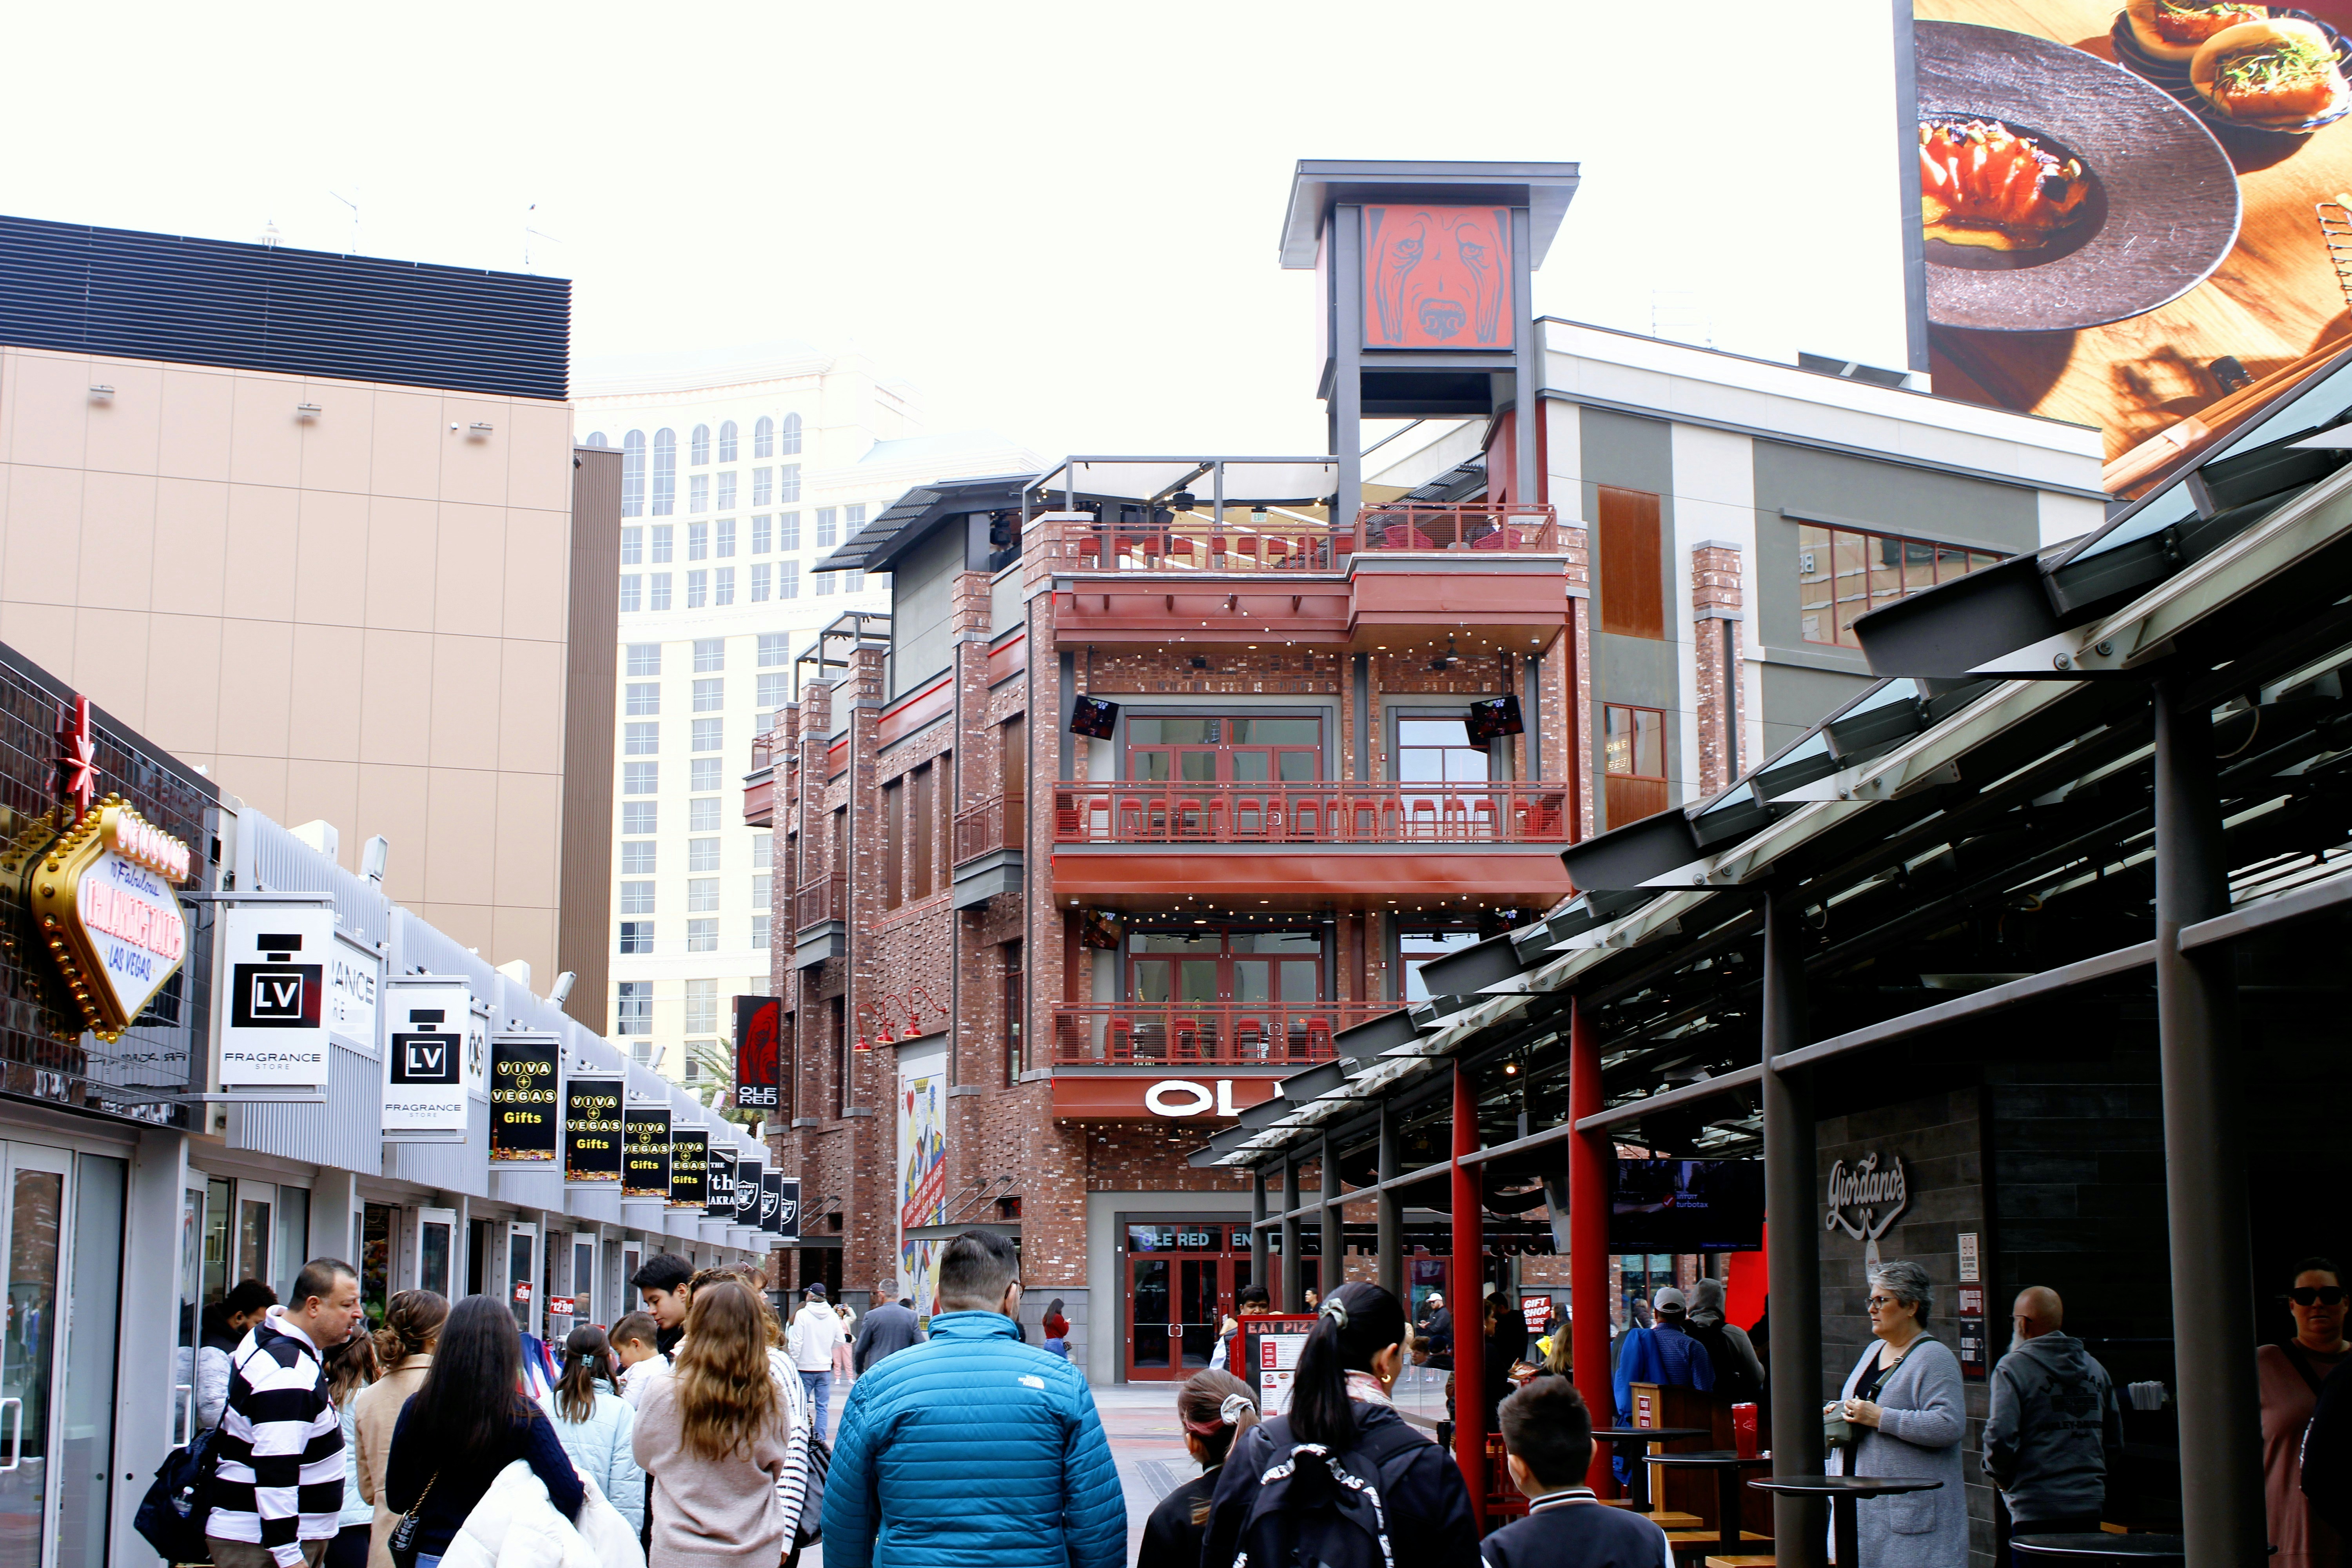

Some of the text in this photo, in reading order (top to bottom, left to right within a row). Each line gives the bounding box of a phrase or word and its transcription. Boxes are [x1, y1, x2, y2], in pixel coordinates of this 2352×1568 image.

[118, 815, 191, 875] WELCOME
[117, 861, 160, 897] Fabulous
[149, 905, 183, 961] TACOS
[109, 944, 152, 982] LAS VEGAS
[332, 959, 374, 1005] ANCE
[256, 982, 299, 1007] LV
[224, 1053, 321, 1062] FRAGRANCE
[410, 1048, 443, 1068] LV
[498, 1063, 550, 1074] VIVA
[492, 1091, 555, 1102] VEGAS
[739, 1086, 777, 1096] OLE
[572, 1097, 617, 1107] VIVA
[739, 1095, 777, 1105] RED
[1145, 1080, 1285, 1117] OL
[504, 1112, 542, 1123] Gifts
[566, 1121, 621, 1130] VEGAS
[626, 1123, 665, 1132] VIVA
[576, 1139, 609, 1149] Gifts
[623, 1145, 669, 1153] VEGAS
[630, 1160, 659, 1169] Gifts
[672, 1176, 698, 1184] Gifts
[904, 1200, 914, 1222] LOVE
[922, 1181, 928, 1198] ME
[933, 1161, 943, 1185] HERE
[929, 1191, 935, 1209] ME
[935, 1181, 943, 1201] OUT
[1826, 1152, 1906, 1231] Giordano's
[1142, 1233, 1172, 1246] OLE
[1178, 1233, 1210, 1246] RED
[1524, 1298, 1547, 1308] GIFT
[1523, 1306, 1550, 1318] SHOP
[1248, 1322, 1277, 1333] EAT
